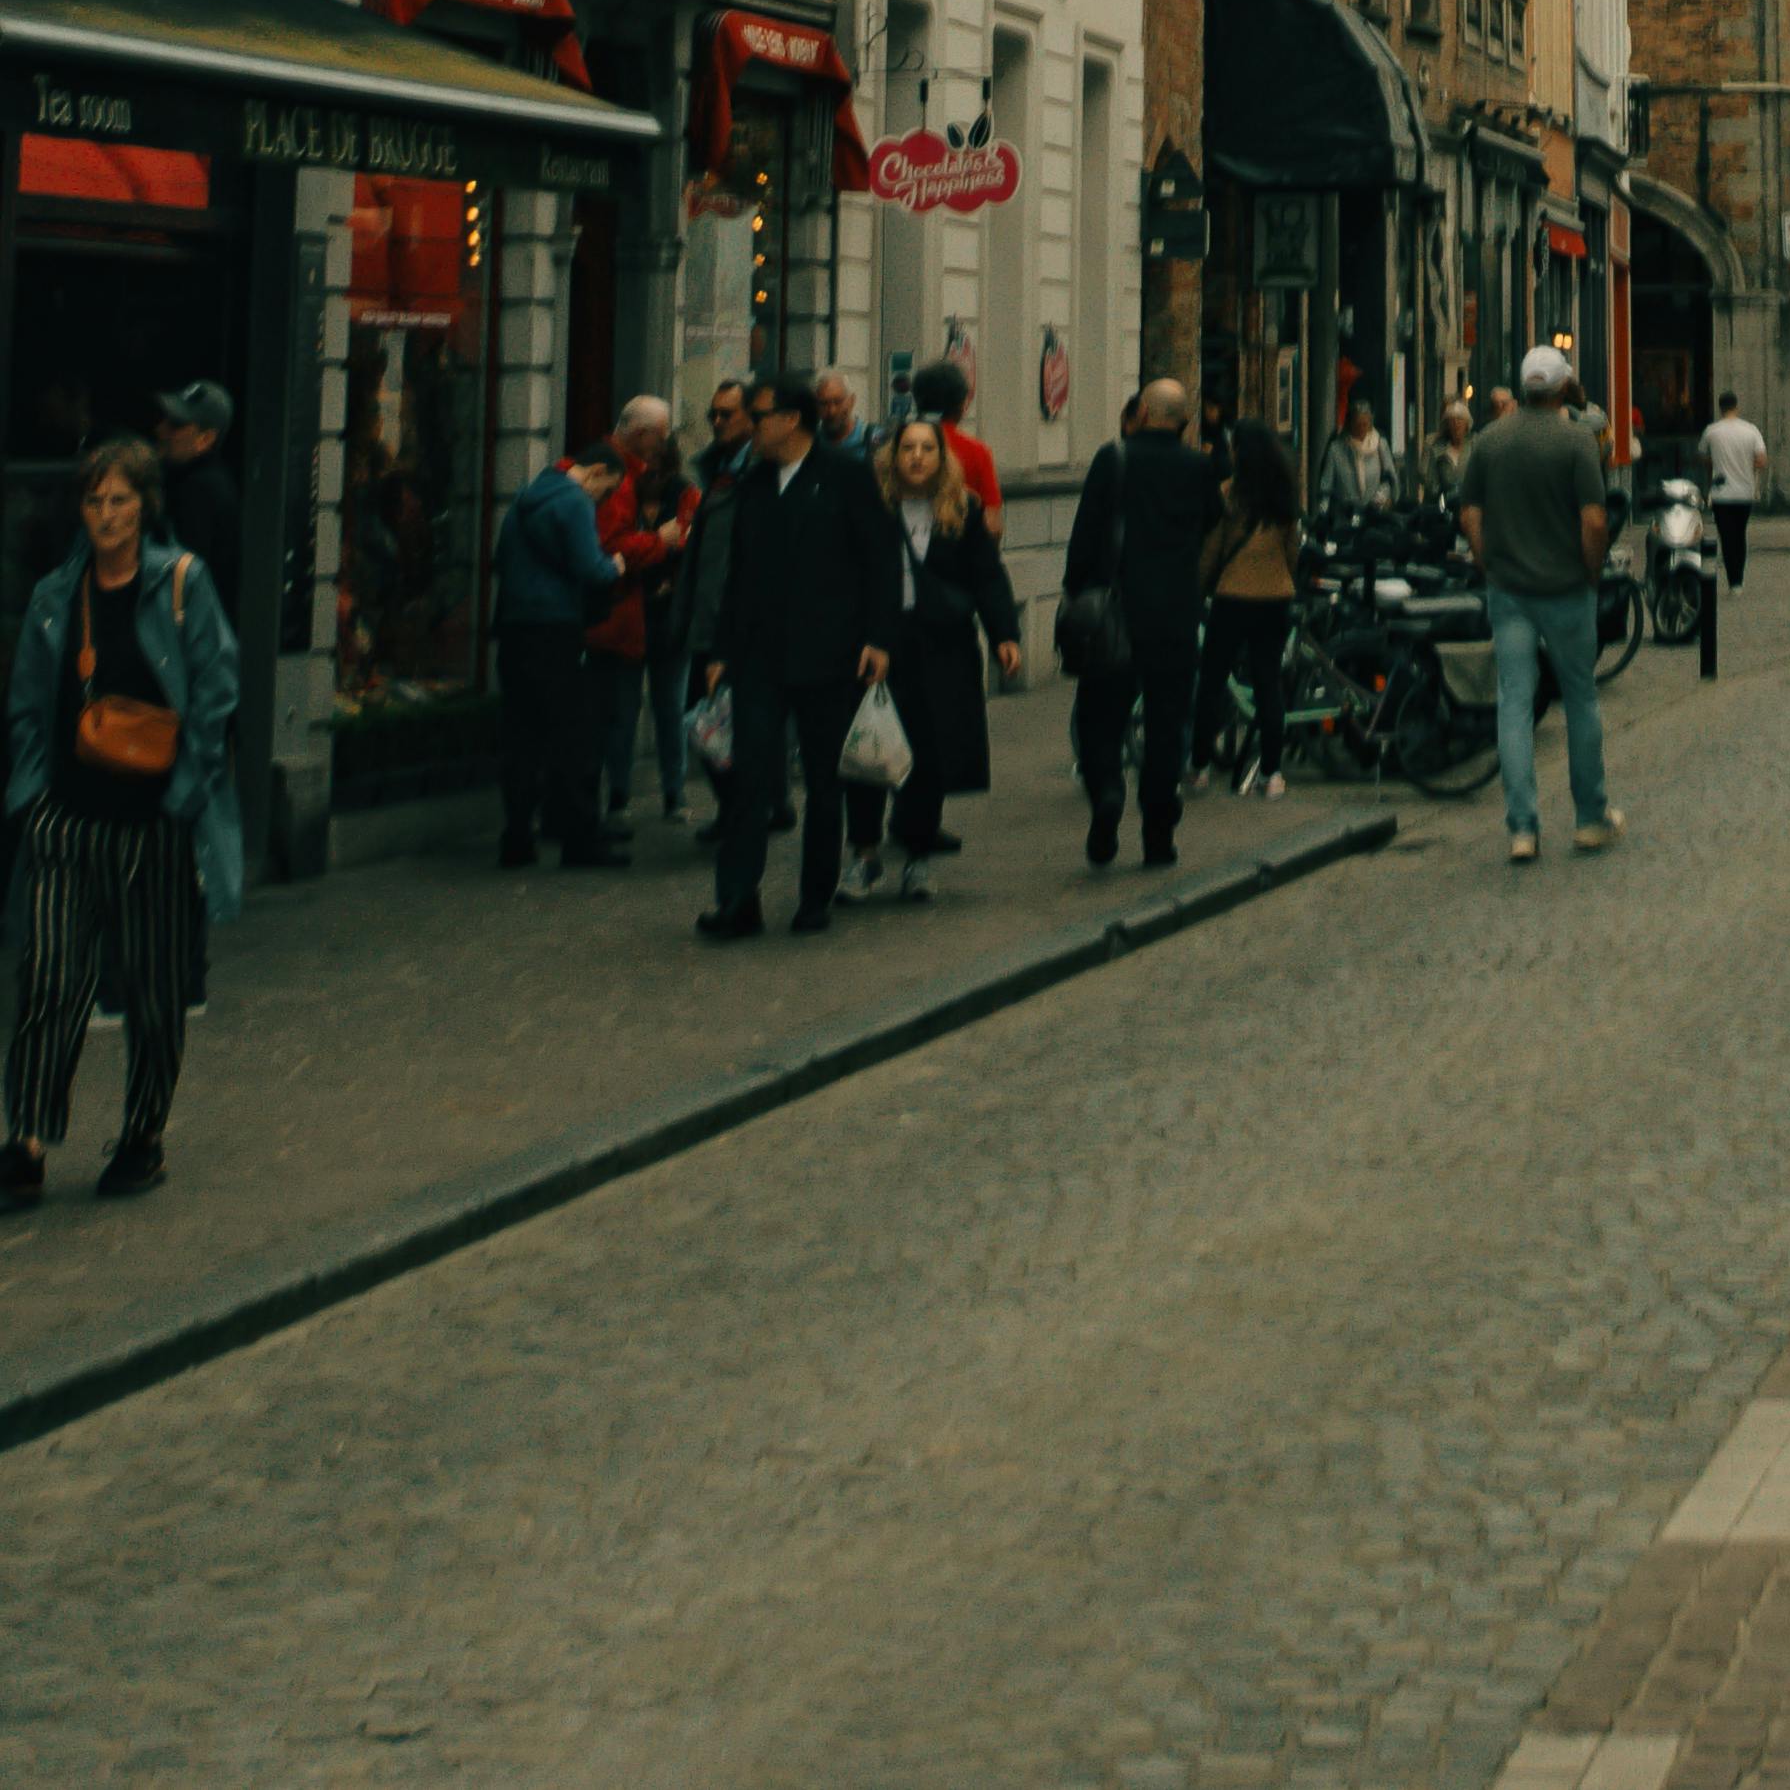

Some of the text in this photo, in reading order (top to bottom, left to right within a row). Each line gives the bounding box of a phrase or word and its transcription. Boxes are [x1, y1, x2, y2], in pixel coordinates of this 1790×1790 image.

[32, 72, 73, 126] Tea
[242, 98, 323, 159] PLACE
[328, 107, 361, 165] DE
